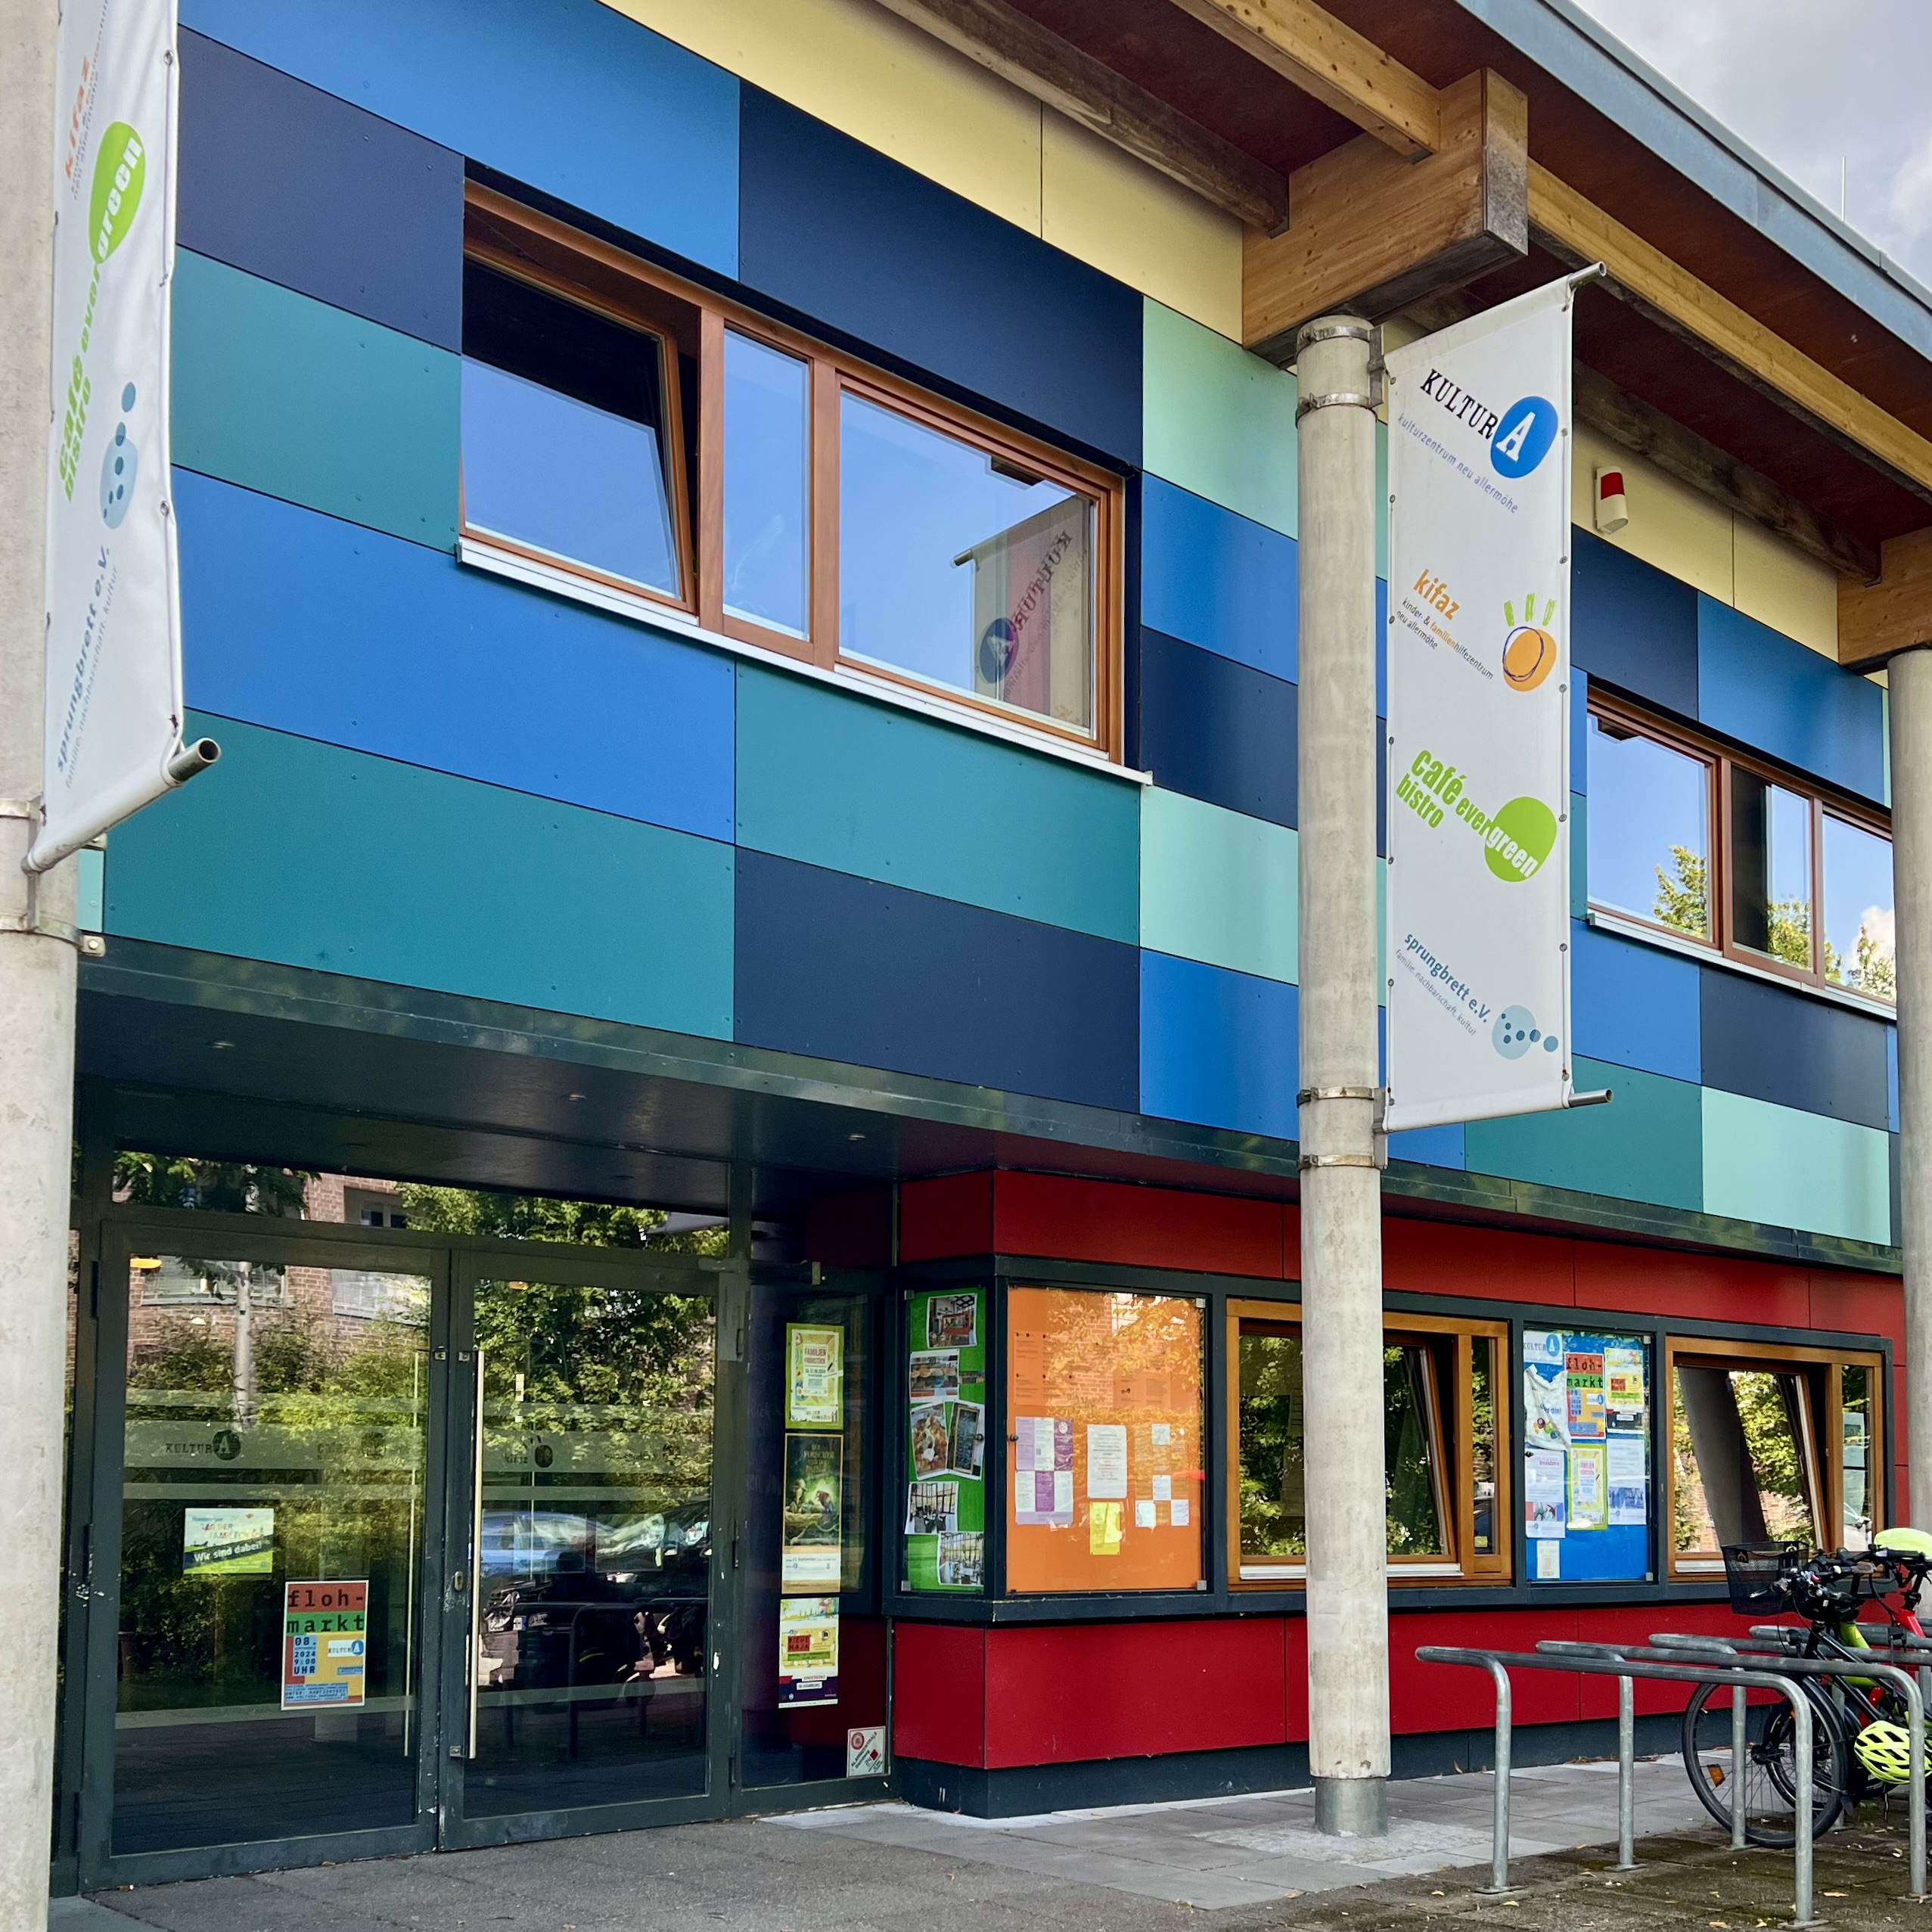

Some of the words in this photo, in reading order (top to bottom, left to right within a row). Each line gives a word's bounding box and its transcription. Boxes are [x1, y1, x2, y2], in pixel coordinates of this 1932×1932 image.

[1420, 368, 1499, 440] KULTUR
[1496, 411, 1536, 463] A
[1397, 413, 1457, 466] kulturzentrum
[1456, 462, 1475, 480] neu
[1474, 476, 1519, 514] allermöhe
[1414, 569, 1460, 621] kifaz
[1396, 610, 1408, 624] neu
[1407, 620, 1438, 650] allermöhe
[1402, 597, 1423, 620] kinder-
[1423, 616, 1430, 626] &
[1430, 622, 1493, 680] familienhilfezentrum
[57, 603, 97, 772] sprungbrett
[95, 545, 110, 598] e.V.
[1396, 773, 1445, 829] bistro
[1404, 933, 1470, 1002] sprungbrett
[1468, 998, 1491, 1023] e.V.
[1457, 1013, 1477, 1036] kultur
[1566, 1358, 1602, 1371] floh-
[1567, 1376, 1604, 1387] markt
[166, 1443, 213, 1454] KULTUR
[194, 1552, 211, 1562] Wir
[213, 1547, 232, 1558] sind
[234, 1541, 262, 1554] dabei!
[287, 1589, 364, 1607] floh-
[287, 1614, 365, 1633] markt
[295, 1637, 316, 1646] 08.
[294, 1666, 315, 1674] UHR
